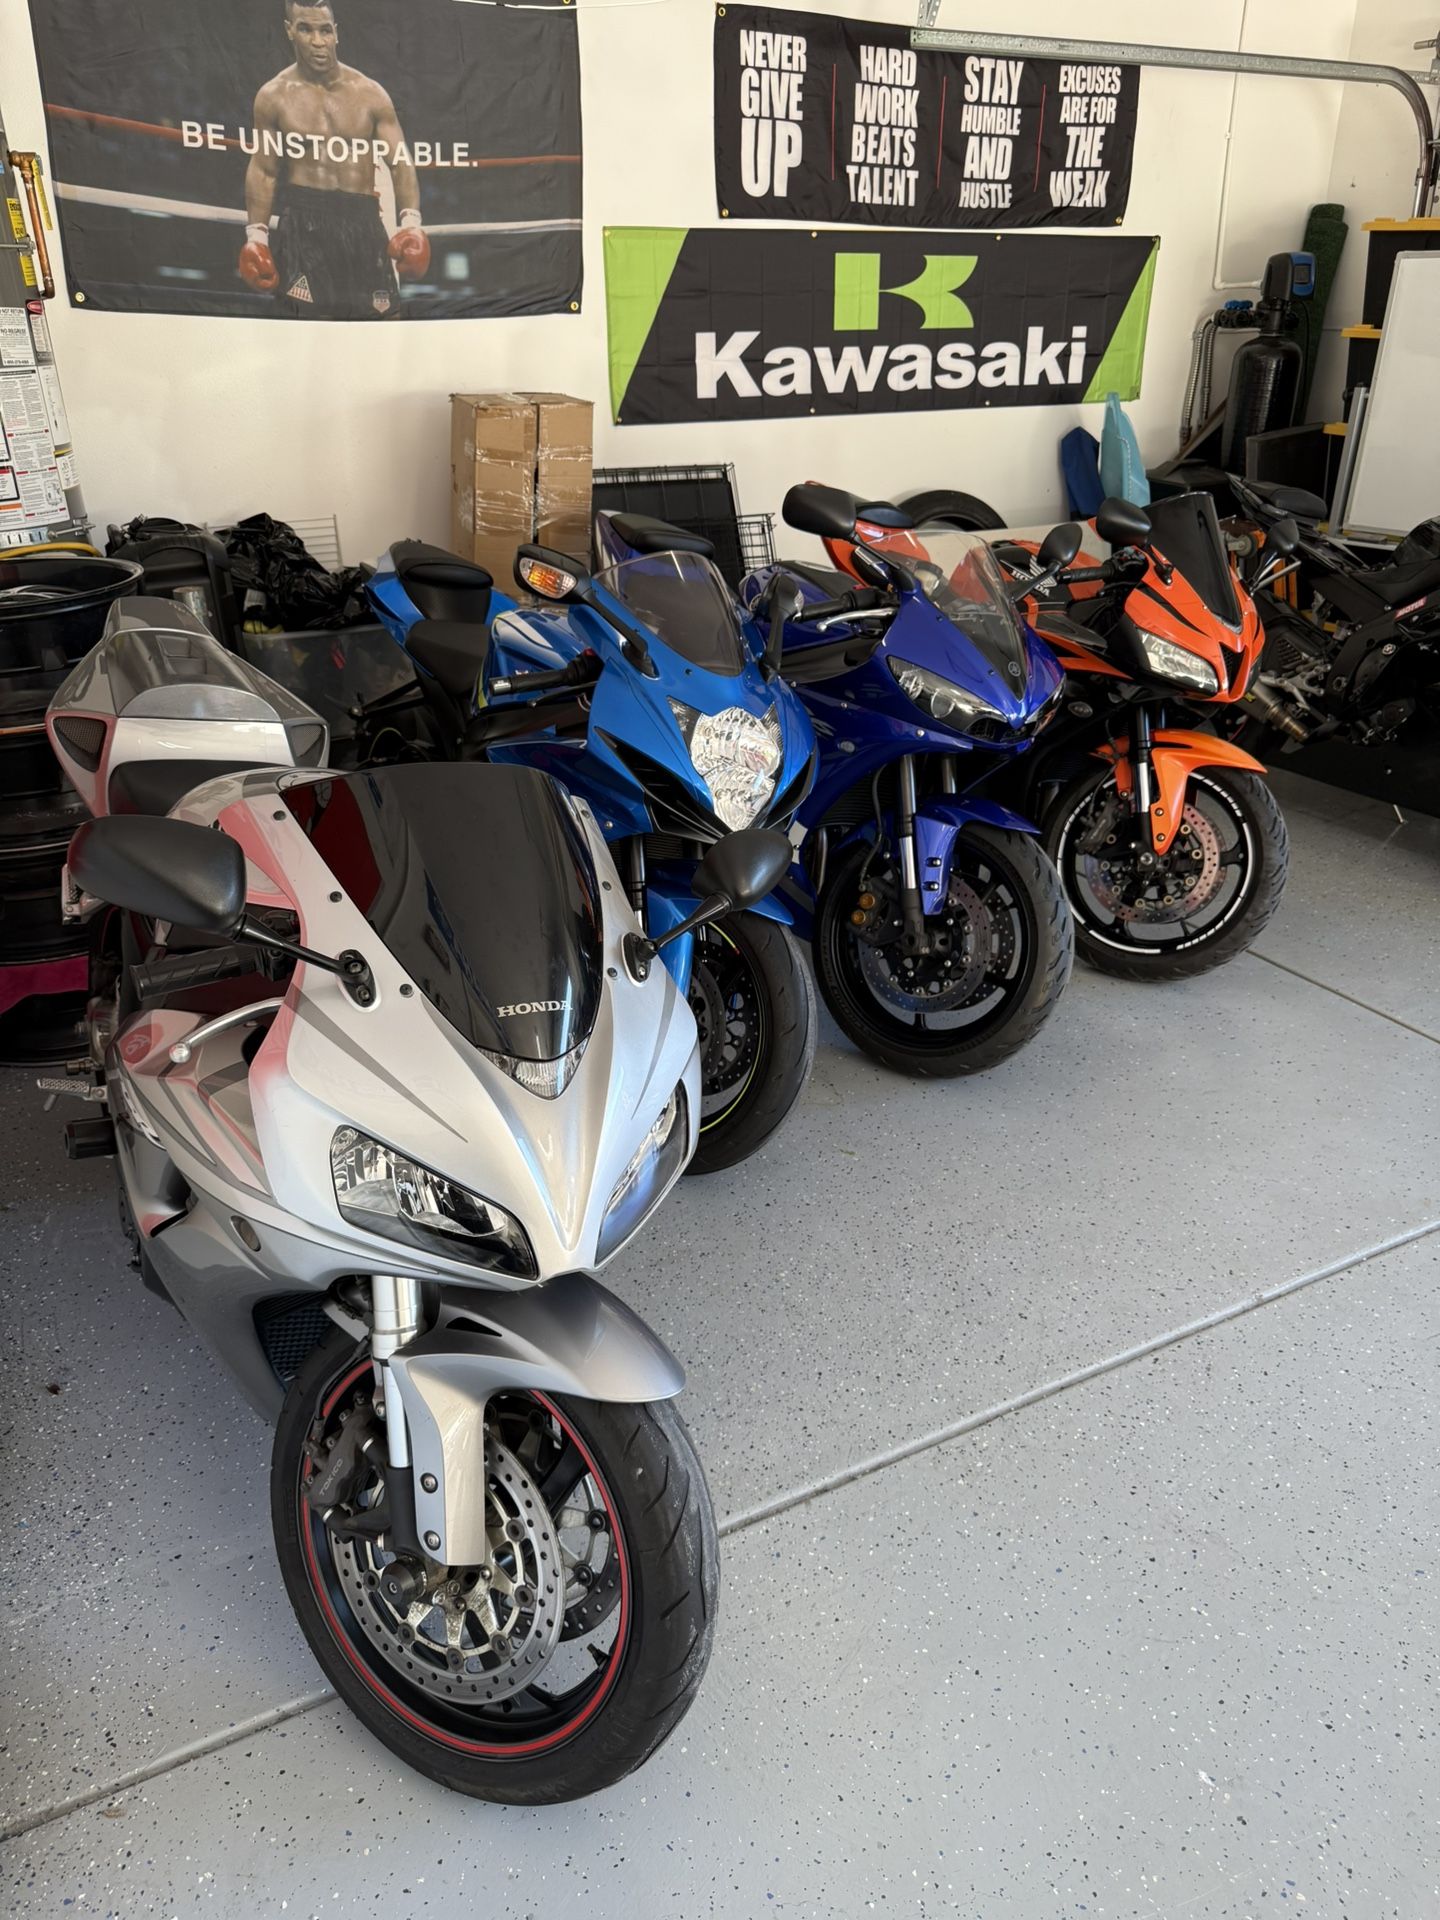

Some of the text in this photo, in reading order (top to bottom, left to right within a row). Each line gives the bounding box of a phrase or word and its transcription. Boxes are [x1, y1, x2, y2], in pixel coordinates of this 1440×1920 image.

[740, 29, 807, 73] NEVER
[859, 45, 917, 87] HARD
[740, 67, 804, 121] GIVE
[964, 55, 1025, 106] STAY
[1059, 65, 1122, 95] EXCUSES
[854, 82, 920, 129] WORK
[960, 104, 1022, 136] HUMBLE
[1059, 96, 1118, 124] ARE FOR
[181, 120, 479, 168] BE UNSTOPPABLE.
[740, 118, 804, 198] UP
[850, 124, 917, 168] BEATS
[963, 136, 1014, 181] AND
[1065, 126, 1107, 169] THE
[846, 165, 920, 207] TALENT
[959, 181, 1013, 209] HUSTLE
[1050, 170, 1111, 208] WEAK
[695, 326, 1088, 400] Kawasaki
[1011, 569, 1050, 597] HODA
[497, 1000, 573, 1018] HONDA
[319, 1458, 344, 1496] TOKICO
